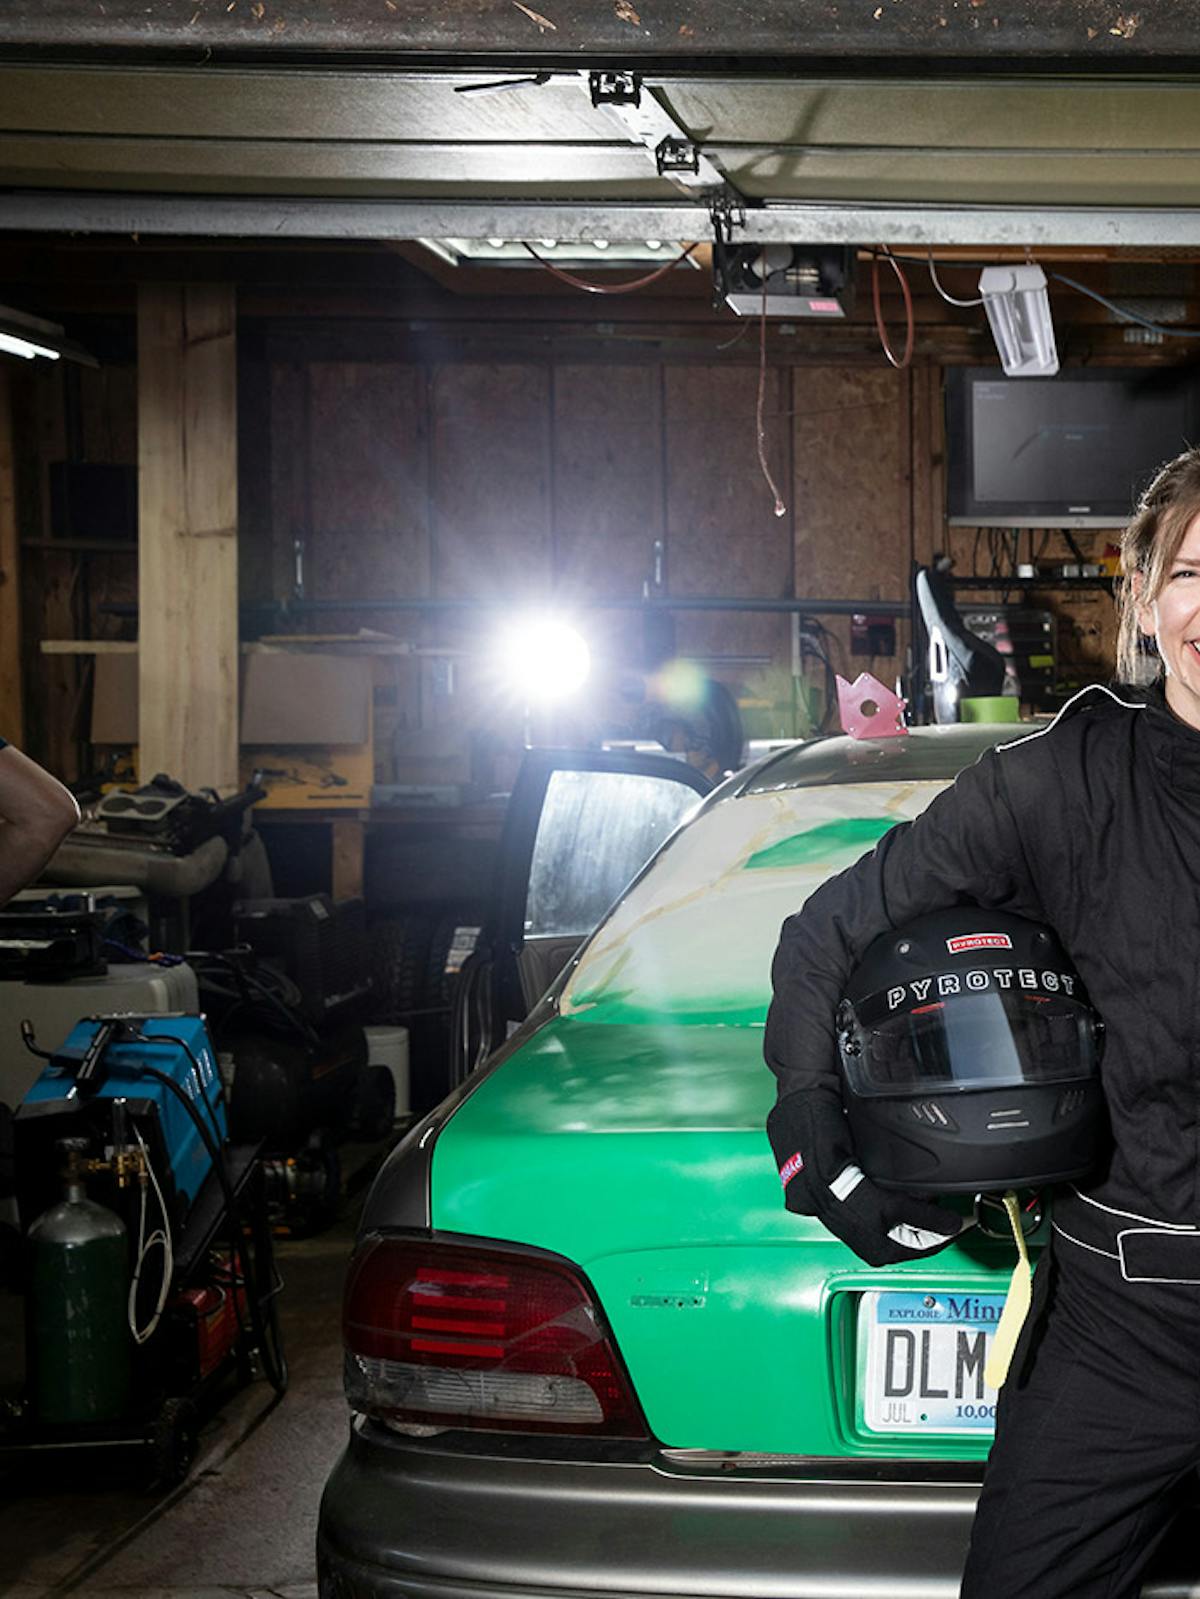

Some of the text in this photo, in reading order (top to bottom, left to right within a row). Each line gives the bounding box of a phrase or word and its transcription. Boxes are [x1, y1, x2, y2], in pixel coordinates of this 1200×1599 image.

[887, 969, 1074, 1010] PYROTECT
[888, 1309, 942, 1320] EXPLORE
[885, 1329, 986, 1399] DLM
[882, 1403, 912, 1423] JUL
